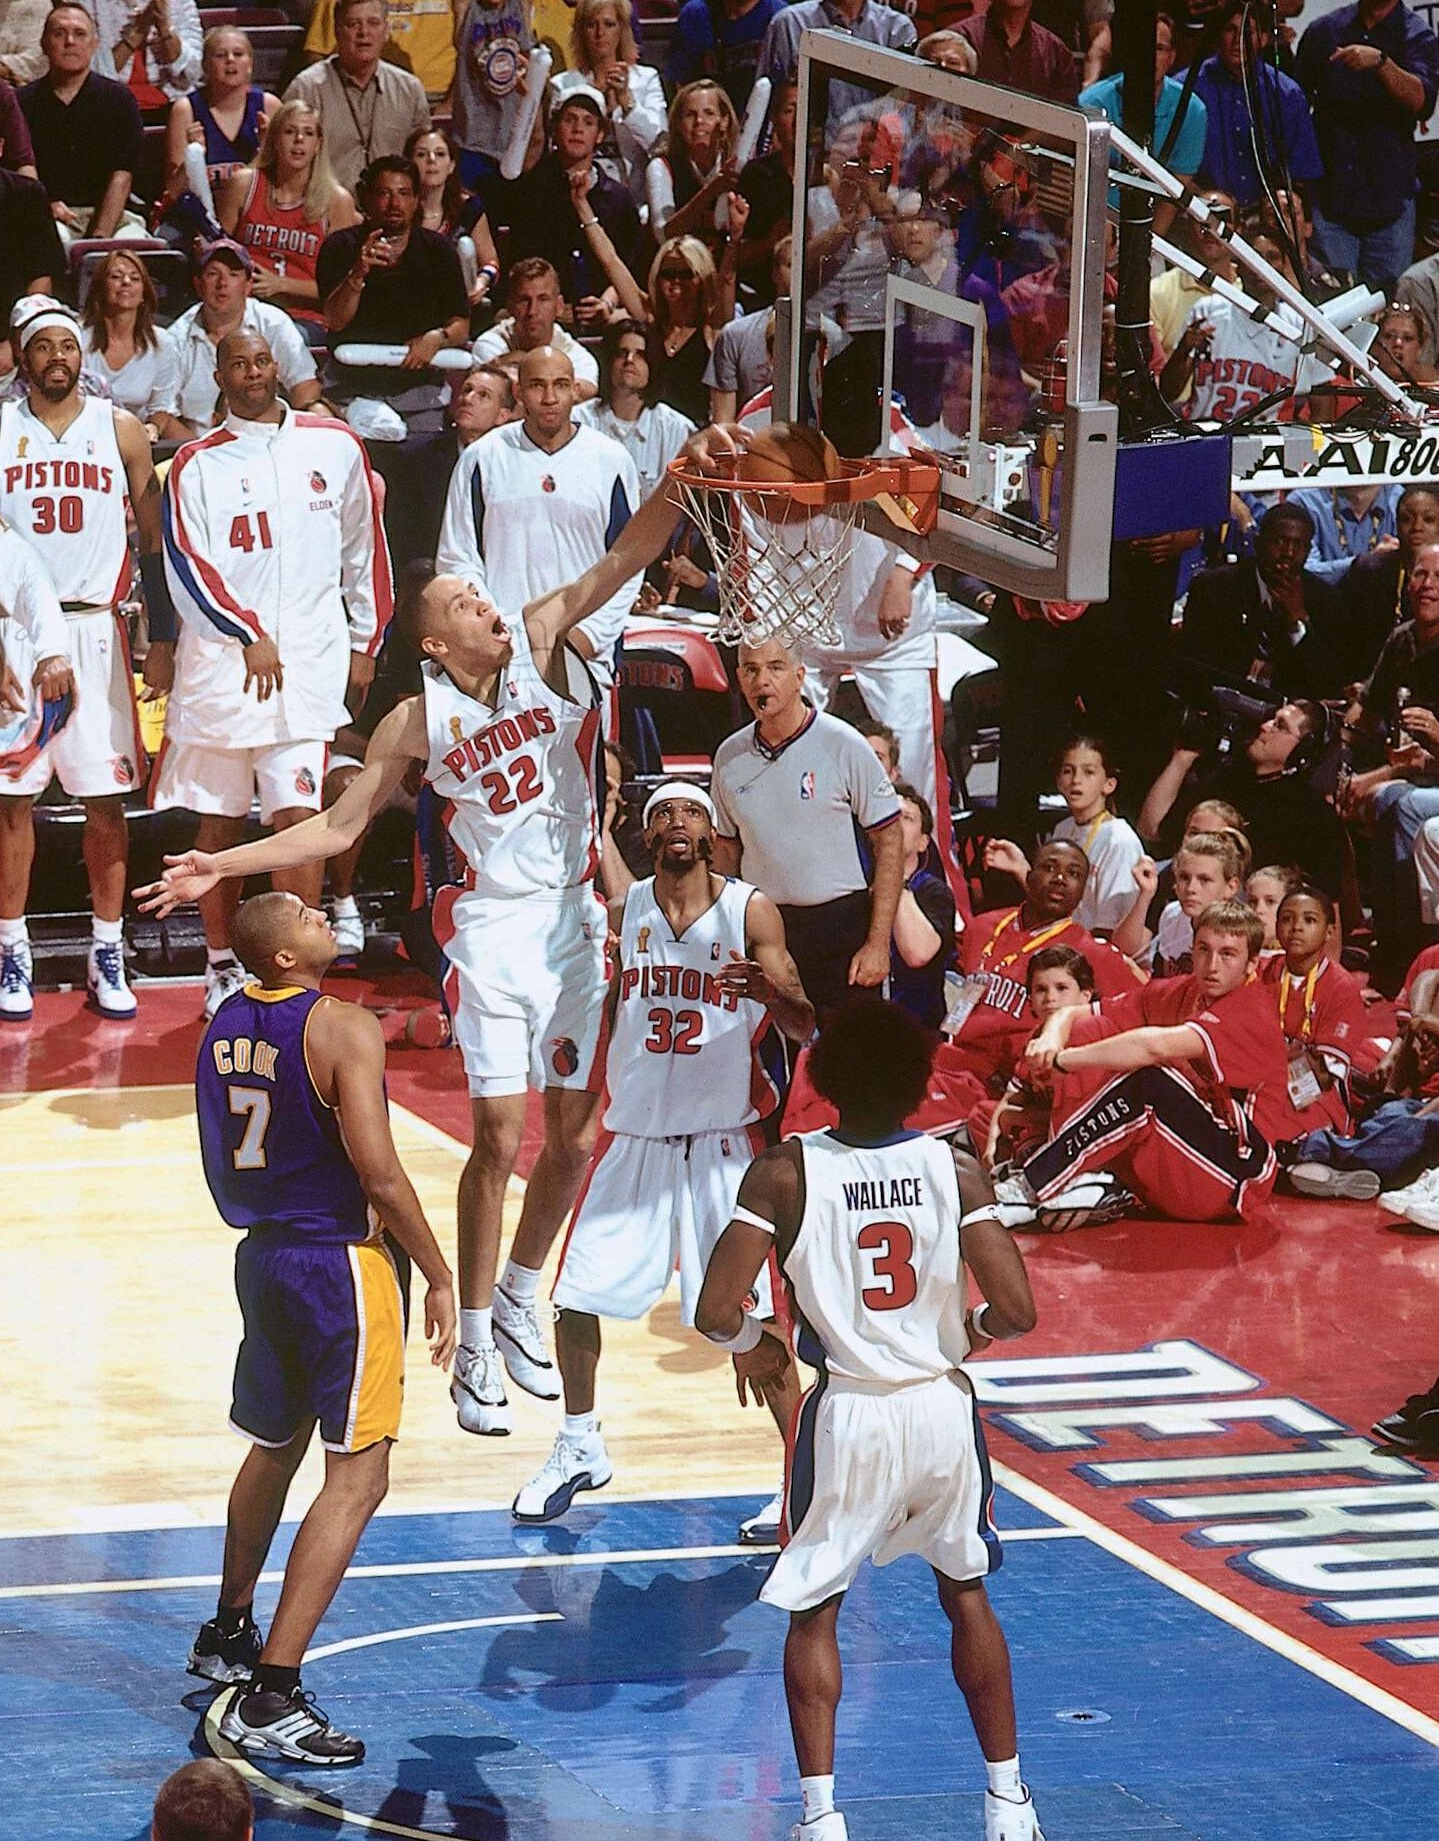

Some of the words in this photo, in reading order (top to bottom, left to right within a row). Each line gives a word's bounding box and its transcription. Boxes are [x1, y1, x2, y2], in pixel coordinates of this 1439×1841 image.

[244, 223, 319, 256] DETROIT
[3, 460, 114, 494] PISTONS
[32, 496, 84, 534] 30
[229, 511, 273, 552] 41
[442, 706, 557, 783] PISTONS
[481, 755, 544, 815] 22
[645, 1007, 704, 1055] 32
[213, 1038, 280, 1082] COOK
[227, 1085, 272, 1171] 7
[1065, 1097, 1131, 1156] PISTONS
[842, 1178, 923, 1211] WALLACE
[857, 1221, 917, 1311] 3
